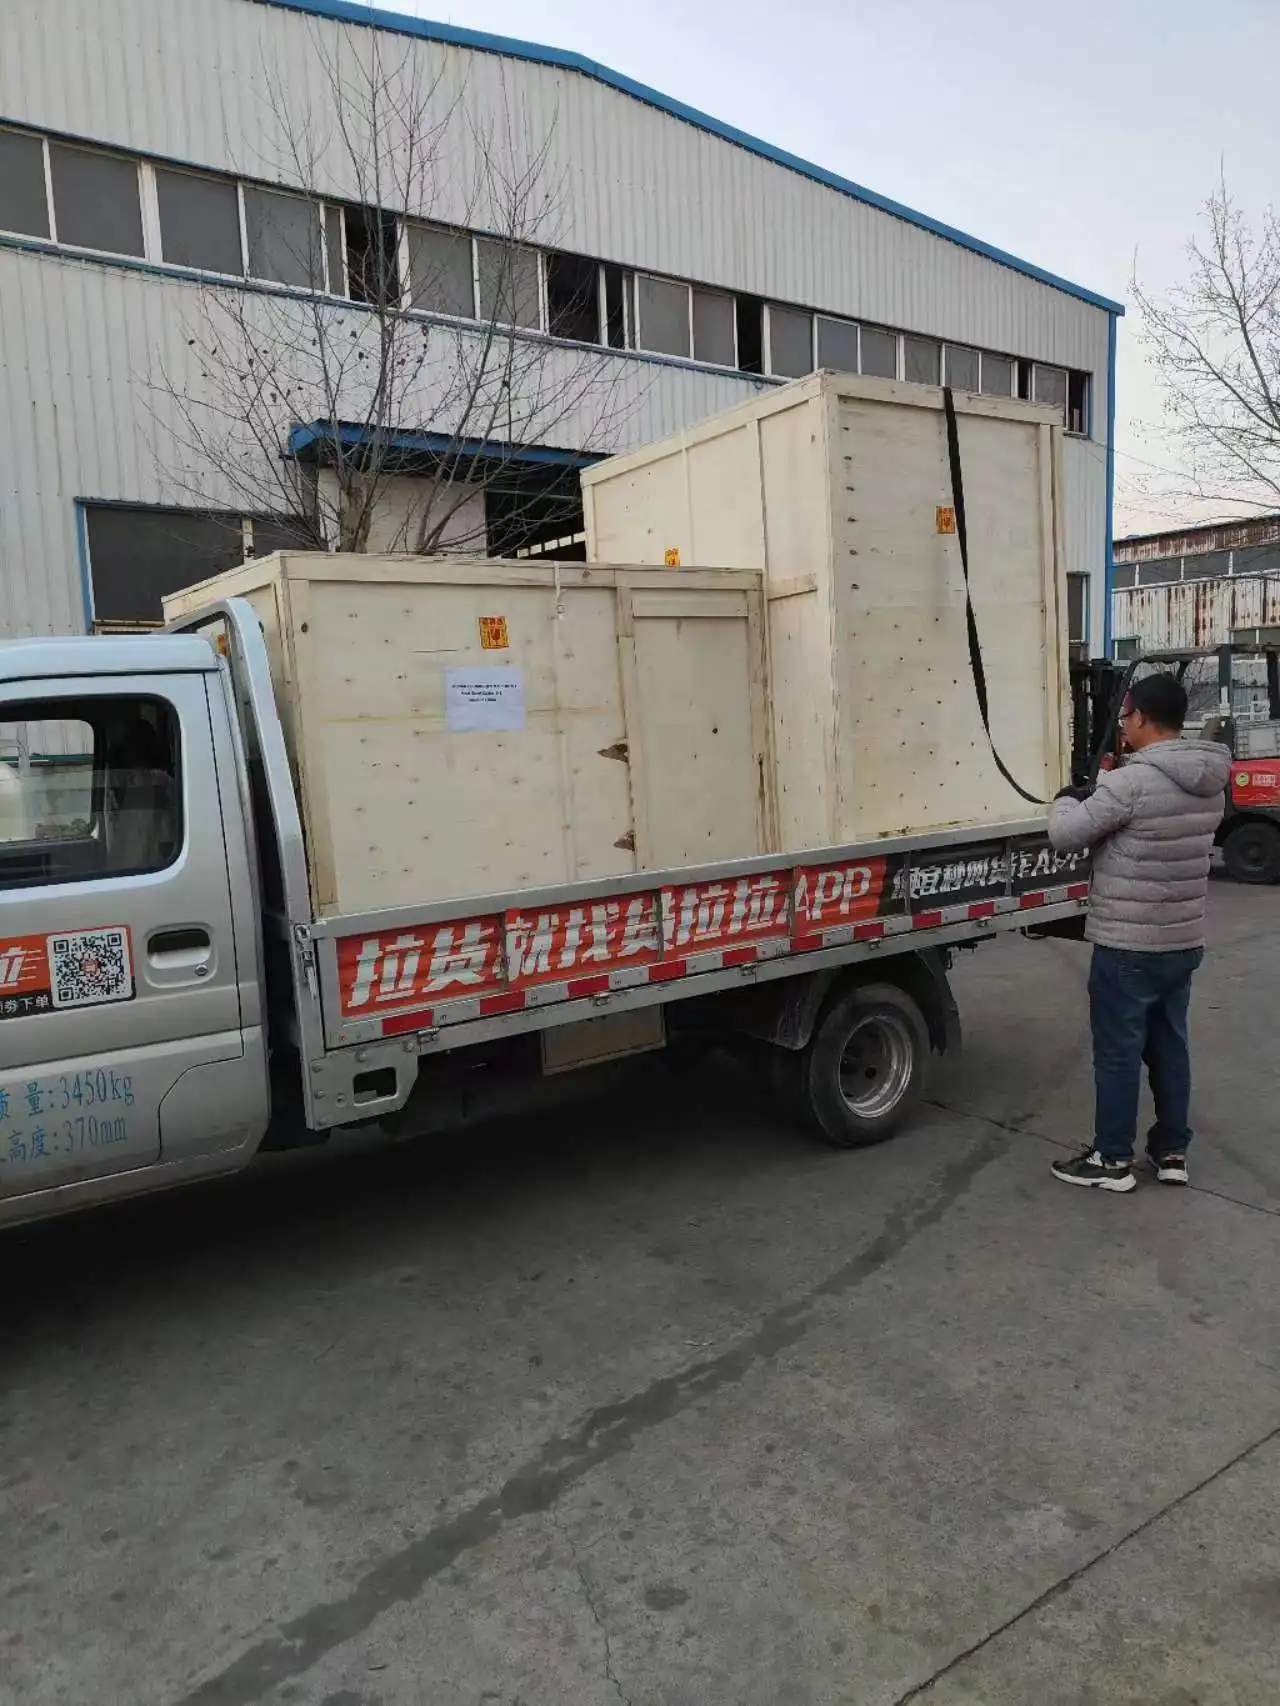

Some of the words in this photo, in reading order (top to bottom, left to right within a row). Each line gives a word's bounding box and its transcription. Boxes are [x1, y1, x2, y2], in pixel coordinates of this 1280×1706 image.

[347, 866, 872, 1009] 拉货就找货拉拉APP
[0, 994, 49, 1014] 券下单
[0, 1115, 128, 1162] 高度:370mm
